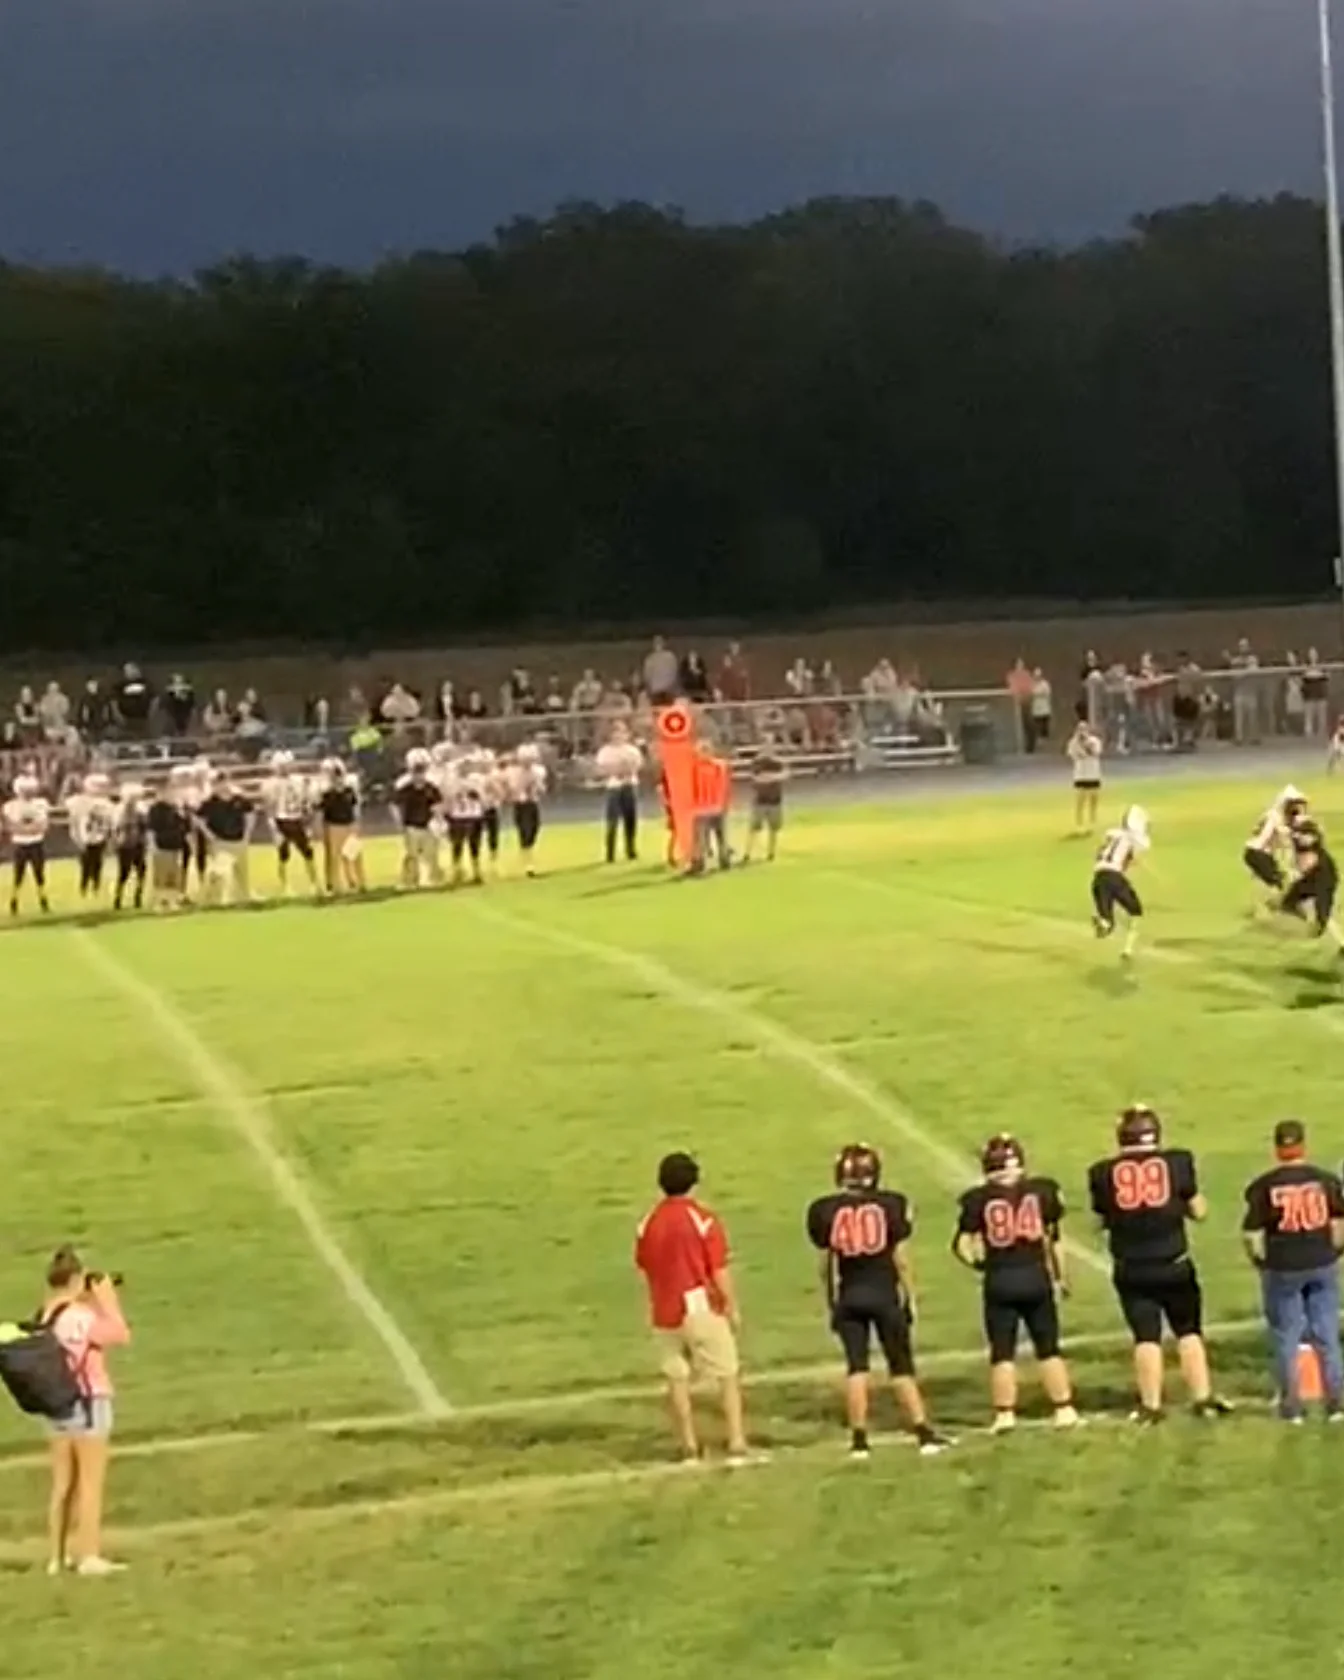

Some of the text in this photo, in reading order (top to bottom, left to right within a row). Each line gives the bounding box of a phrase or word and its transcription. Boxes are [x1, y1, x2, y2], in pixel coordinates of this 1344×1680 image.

[1113, 1157, 1171, 1211] 99
[1270, 1182, 1328, 1231] 70
[830, 1203, 887, 1257] 40
[984, 1194, 1043, 1248] 84
